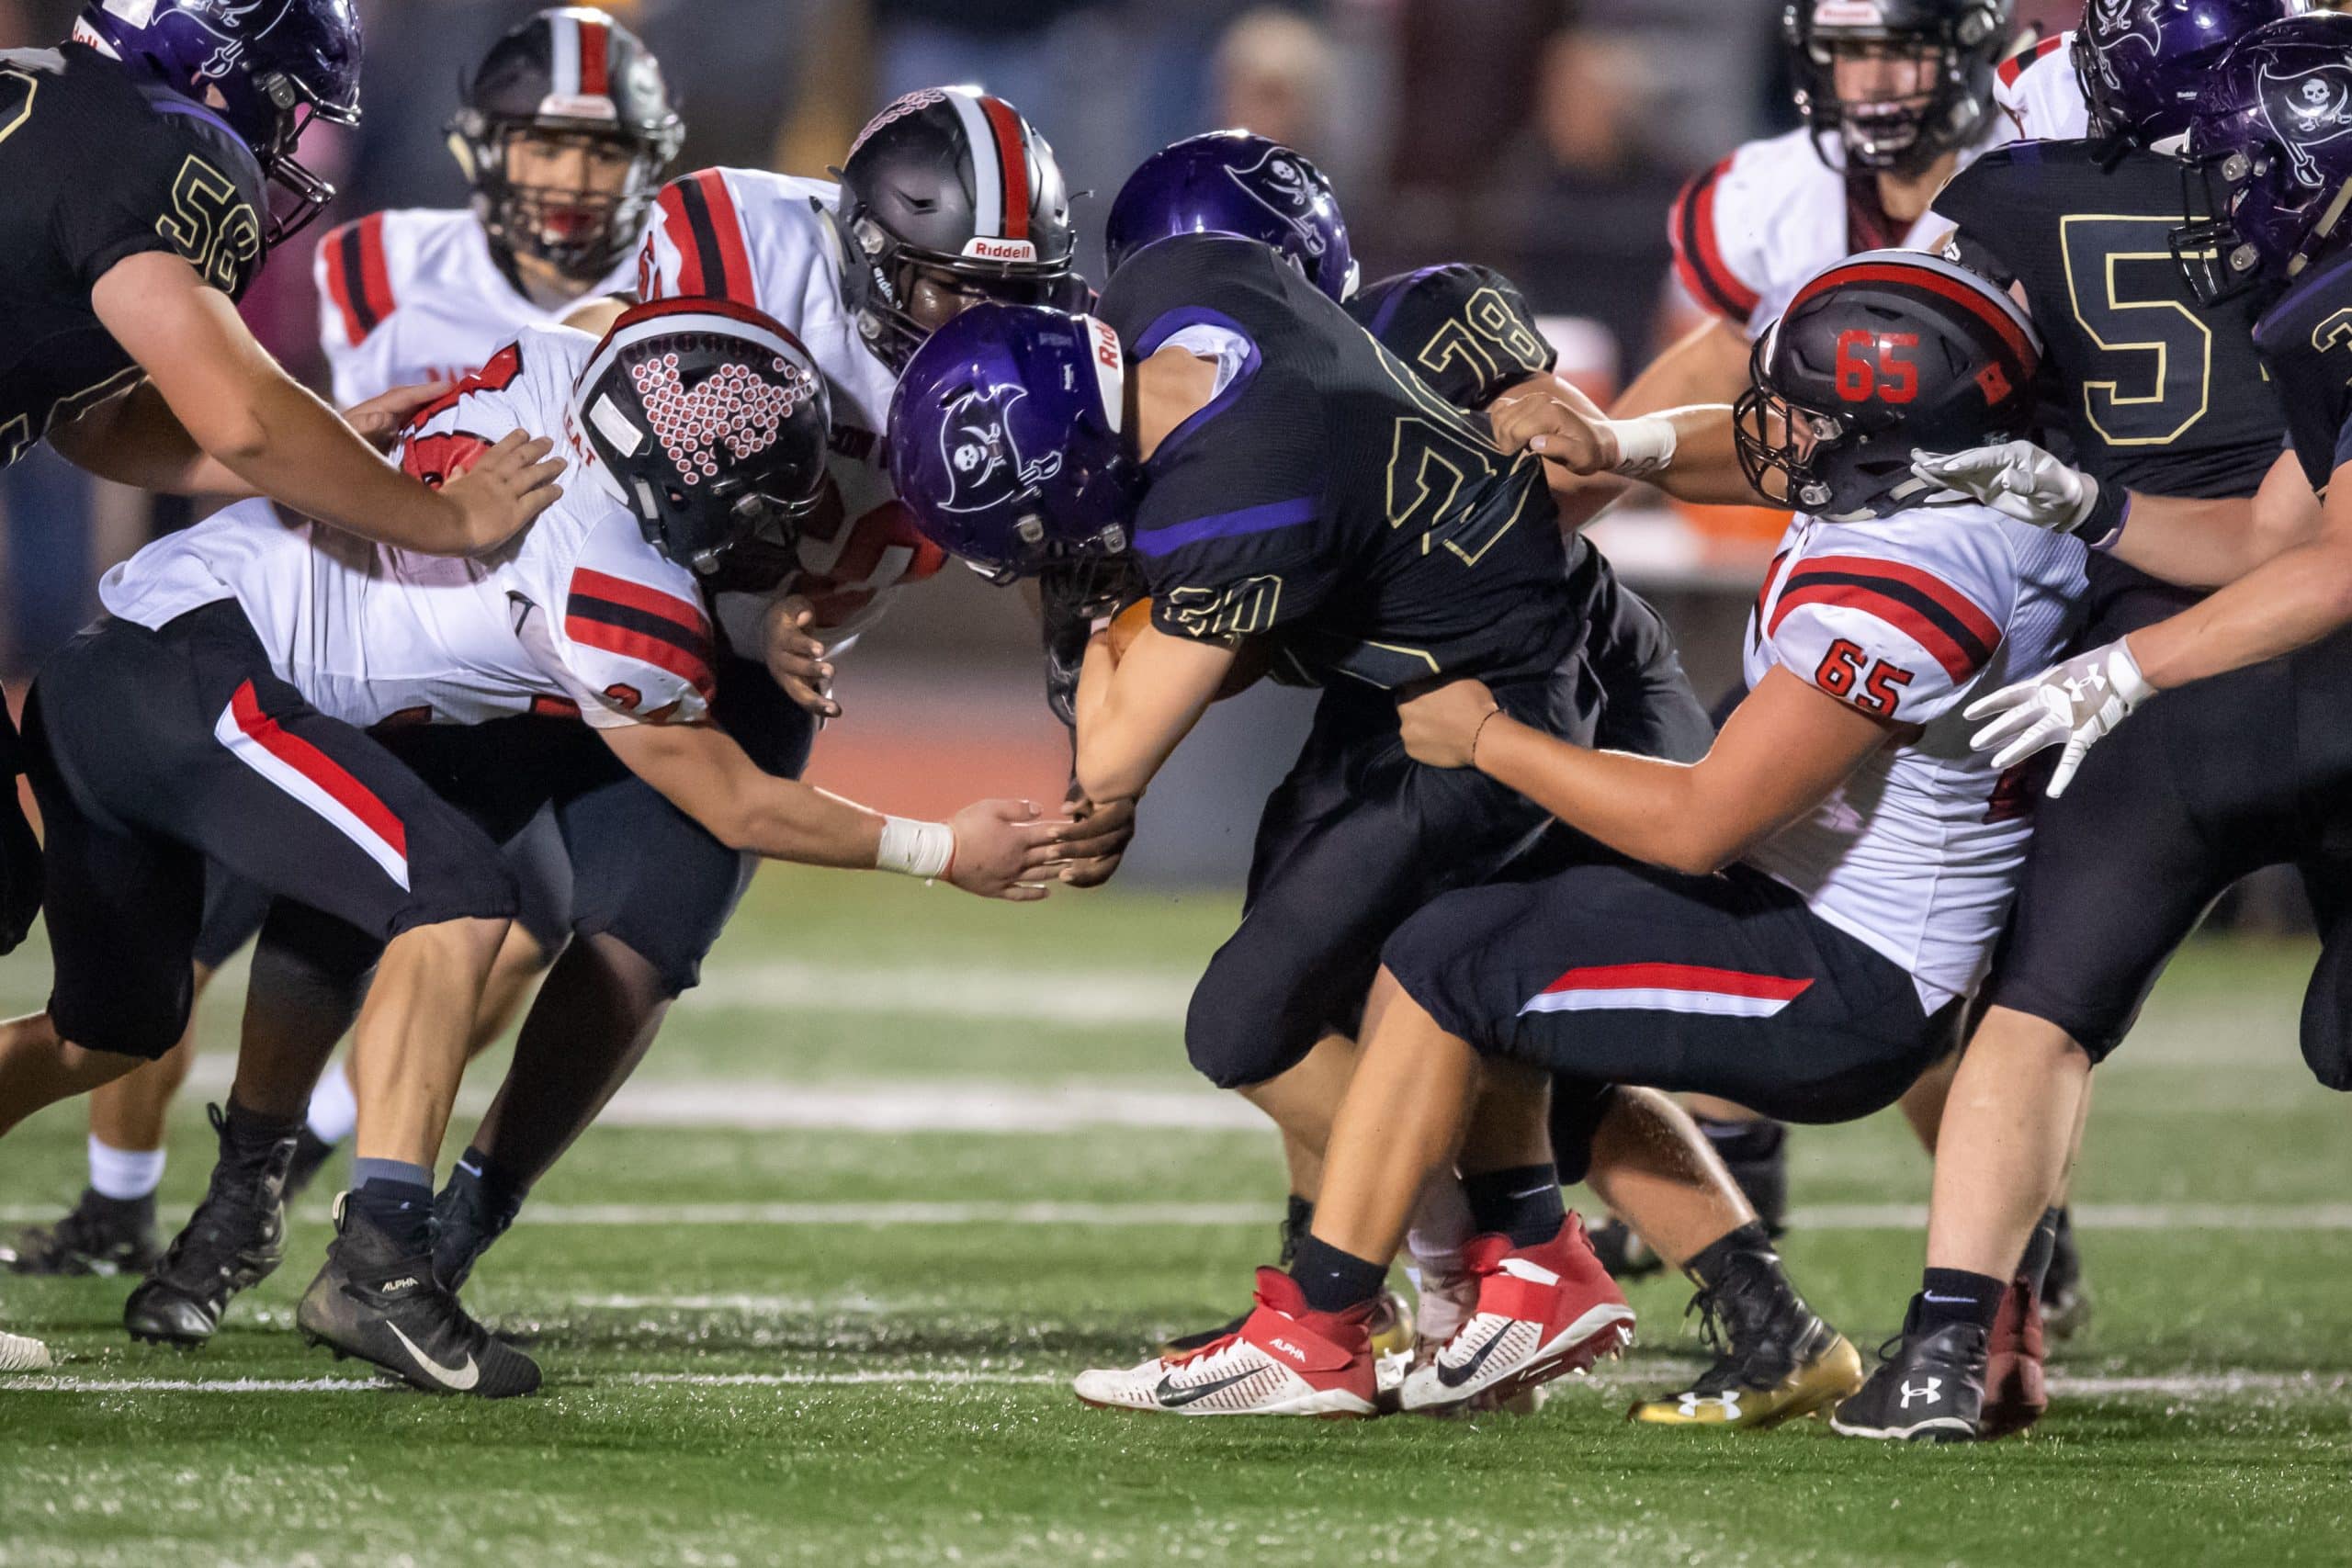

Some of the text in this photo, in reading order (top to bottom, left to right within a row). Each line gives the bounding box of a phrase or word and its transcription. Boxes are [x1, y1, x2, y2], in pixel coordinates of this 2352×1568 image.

[155, 154, 260, 294] 58
[976, 242, 1031, 260] Riddell
[1418, 288, 1548, 393] 78
[1836, 329, 1919, 404] 65
[1815, 637, 1916, 719] 65
[381, 1277, 419, 1293] ALPHA
[1269, 1337, 1306, 1363] ALPHA
